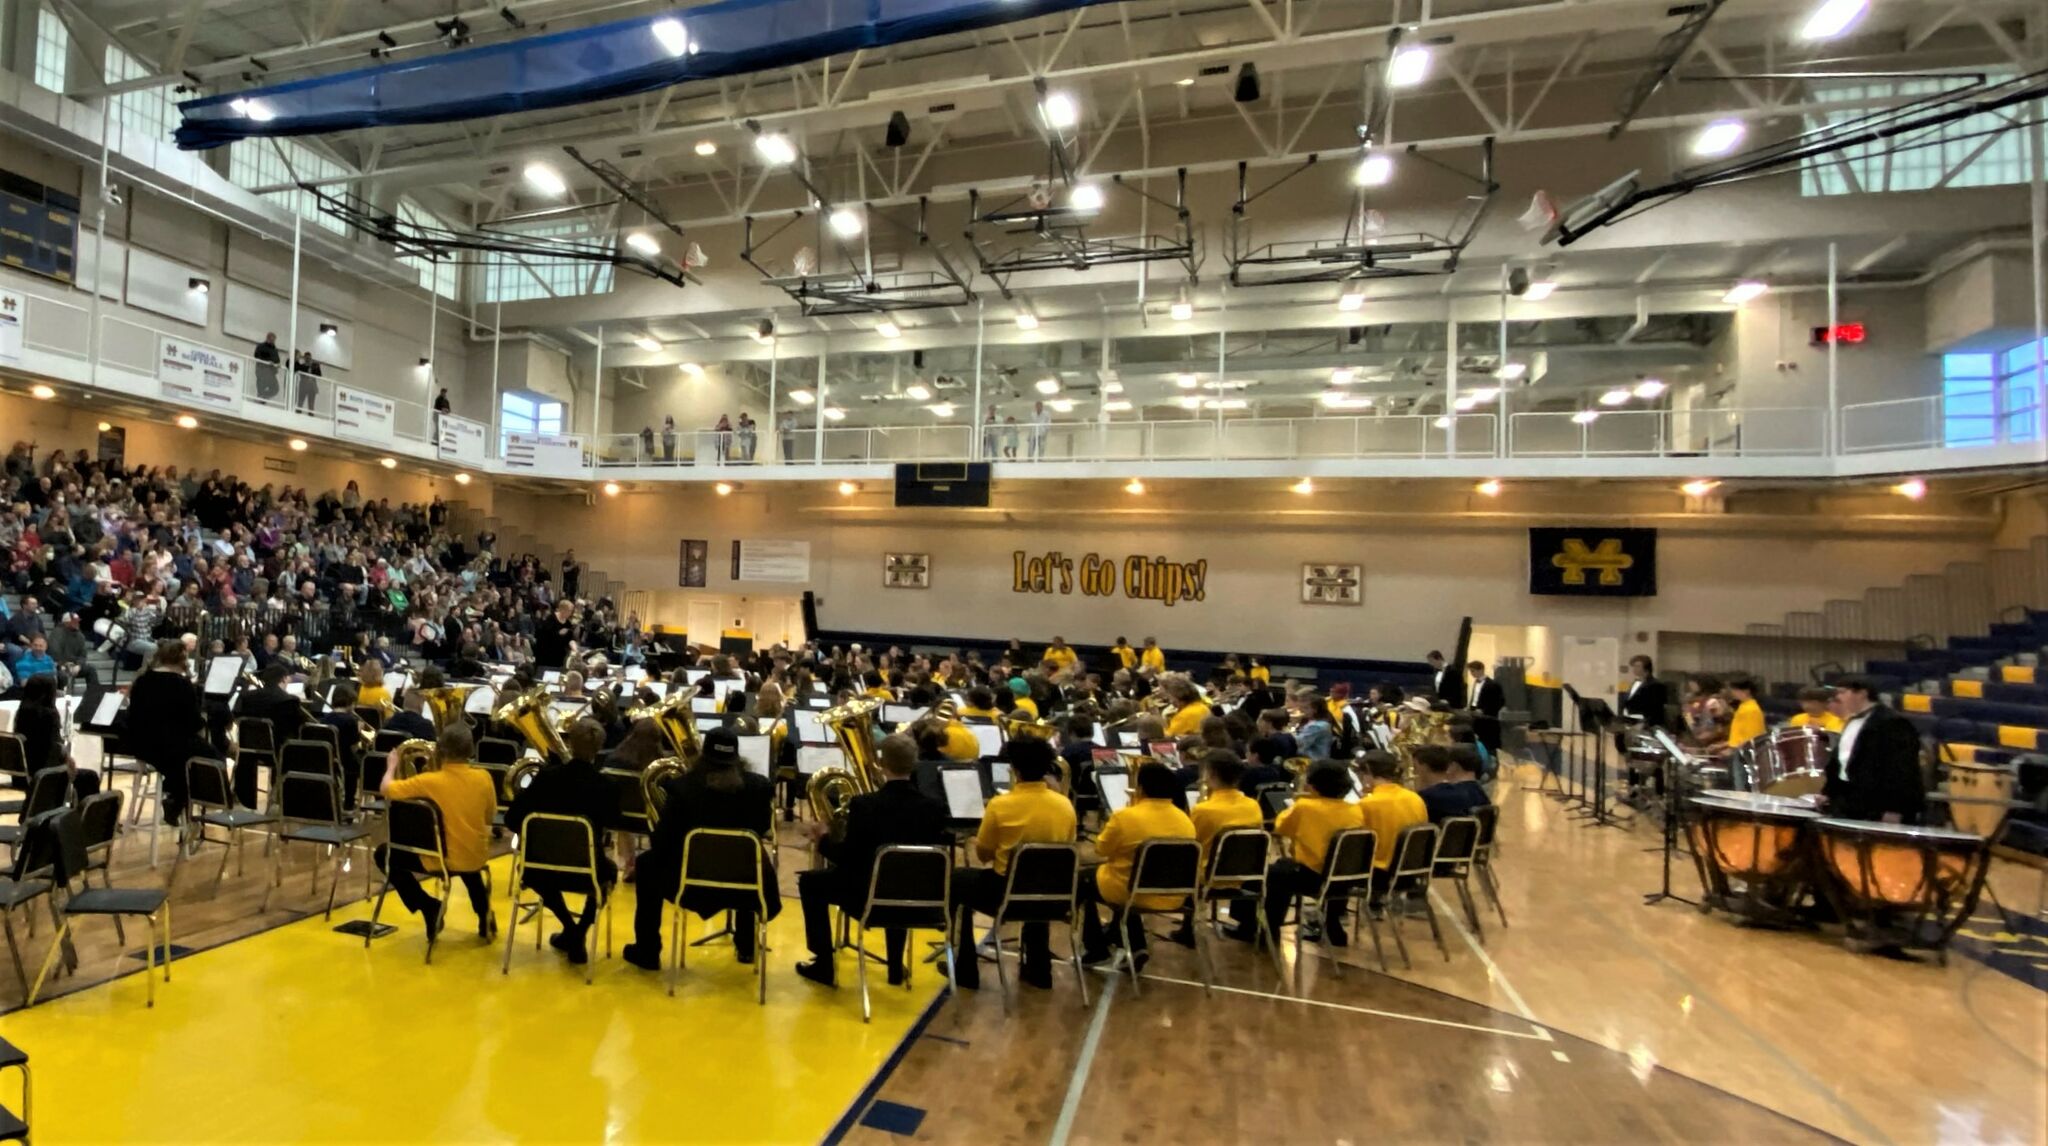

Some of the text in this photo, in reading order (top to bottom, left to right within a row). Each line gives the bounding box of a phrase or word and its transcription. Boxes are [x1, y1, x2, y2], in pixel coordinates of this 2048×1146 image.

[1013, 551, 1207, 606] Let's Go Chips!
